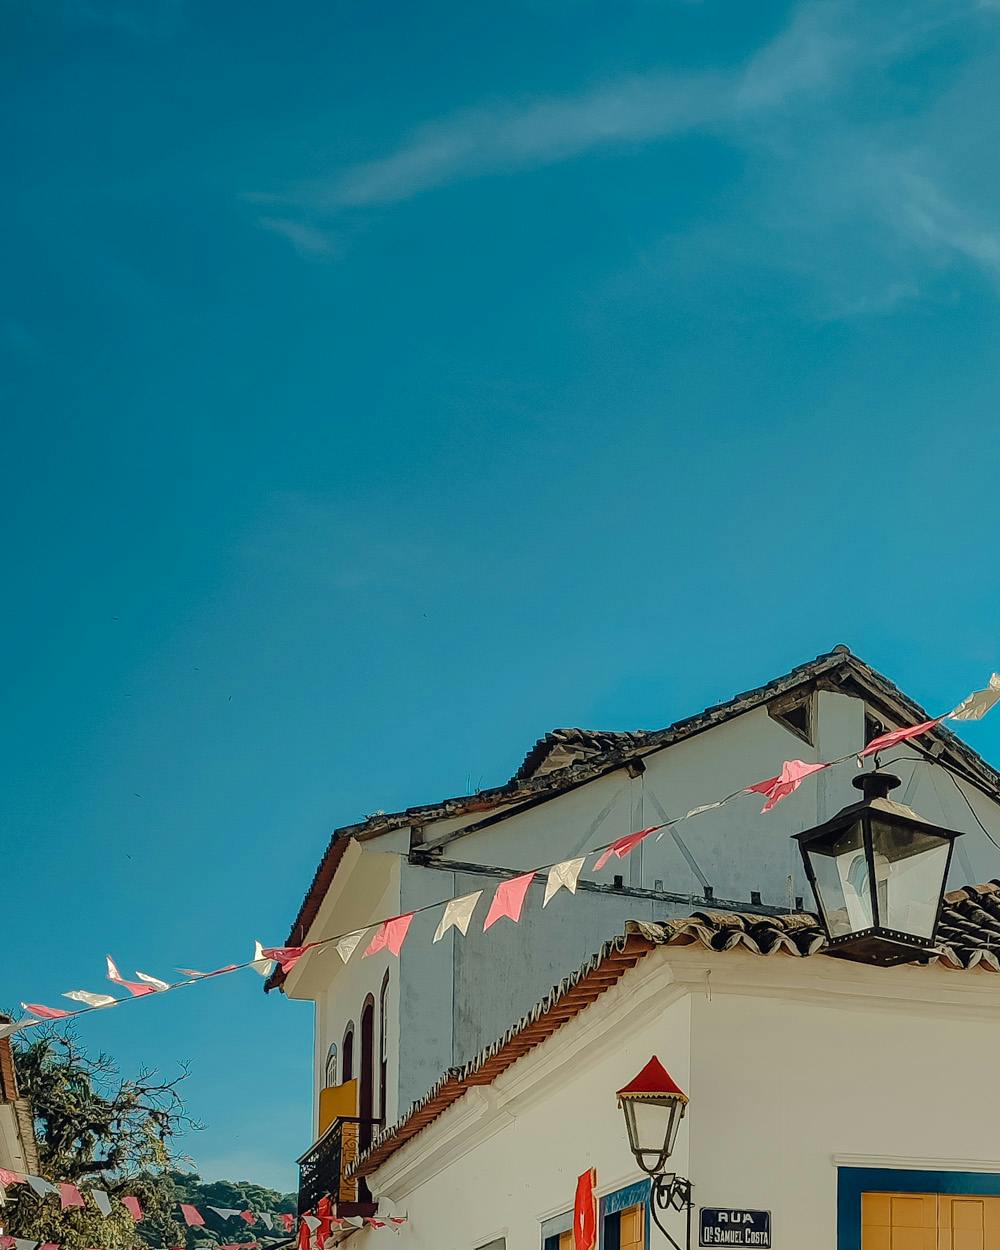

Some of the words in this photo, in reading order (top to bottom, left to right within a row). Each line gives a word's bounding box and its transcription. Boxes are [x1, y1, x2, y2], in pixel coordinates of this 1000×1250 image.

[718, 1212, 754, 1223] RUA
[714, 1227, 743, 1243] SAMUEL
[745, 1228, 769, 1245] COSTA
